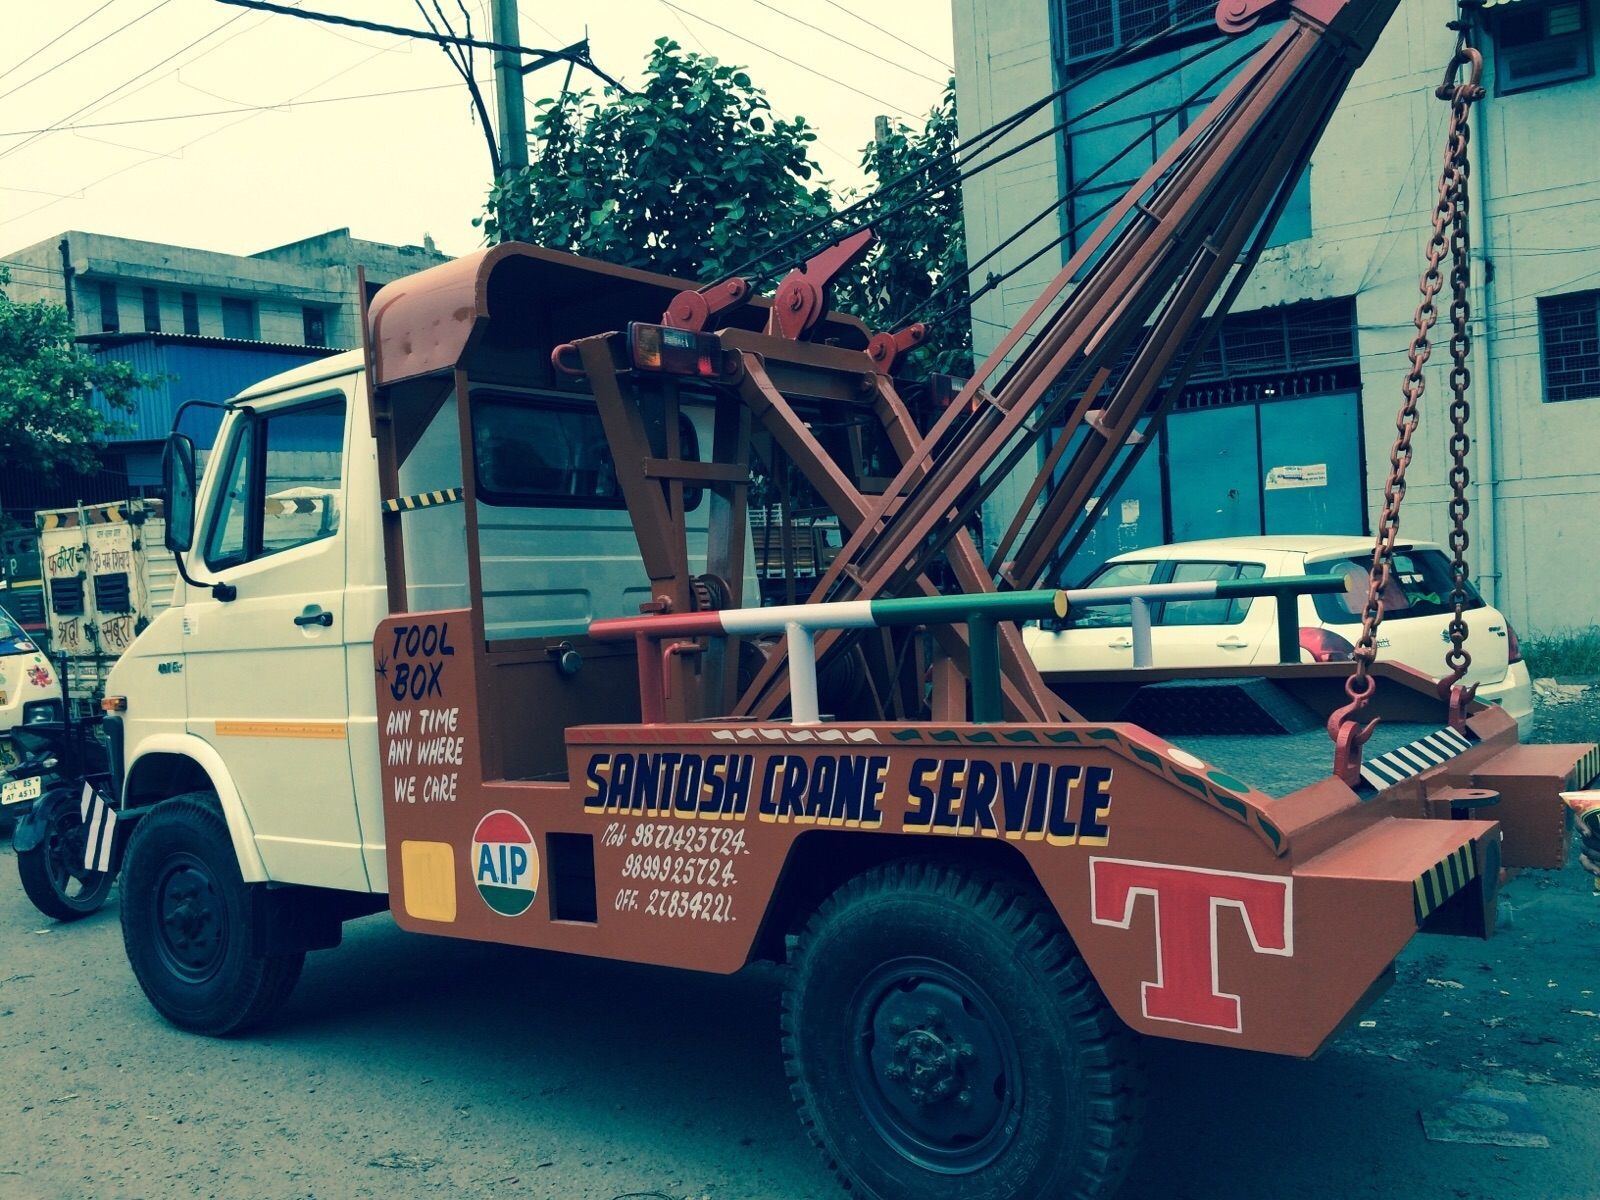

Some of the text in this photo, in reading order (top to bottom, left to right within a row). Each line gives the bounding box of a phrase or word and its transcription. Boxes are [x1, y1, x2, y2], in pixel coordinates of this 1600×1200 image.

[392, 622, 455, 660] TOOL
[390, 660, 444, 702] BOX
[386, 707, 459, 736] ANY TIME
[387, 736, 465, 767] ANY WHERE
[394, 772, 458, 804] WE CARE
[584, 752, 1115, 847] SANTOSH CRANE SERVICE
[1089, 856, 1294, 1033] T
